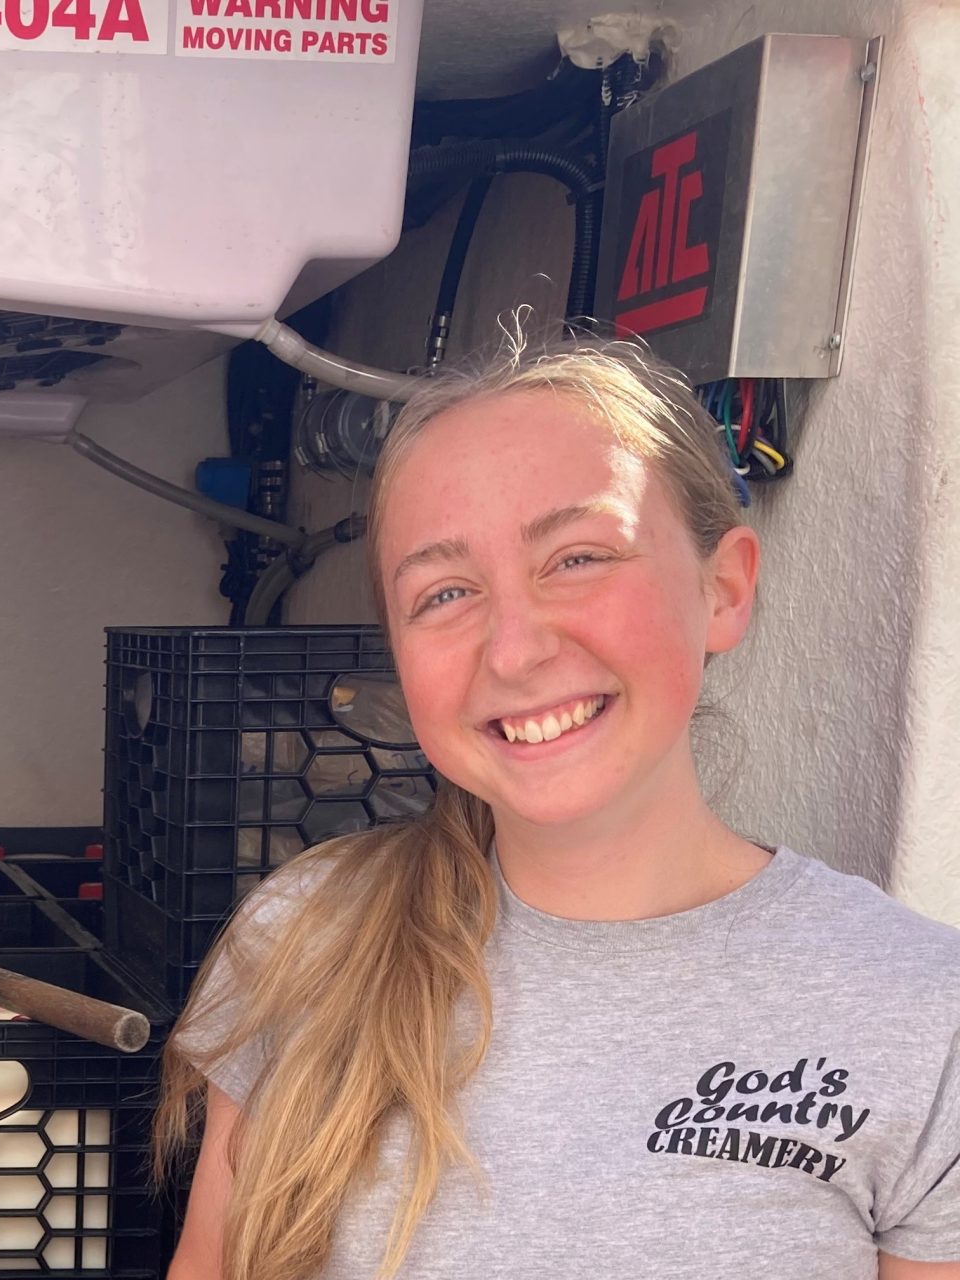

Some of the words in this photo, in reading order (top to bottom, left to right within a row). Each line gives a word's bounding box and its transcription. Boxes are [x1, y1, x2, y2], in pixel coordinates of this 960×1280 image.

[182, 26, 292, 53] MOVING
[301, 30, 389, 56] PARTS
[696, 1057, 849, 1105] God's
[654, 1091, 870, 1142] Country
[646, 1126, 846, 1182] CREAMERY
